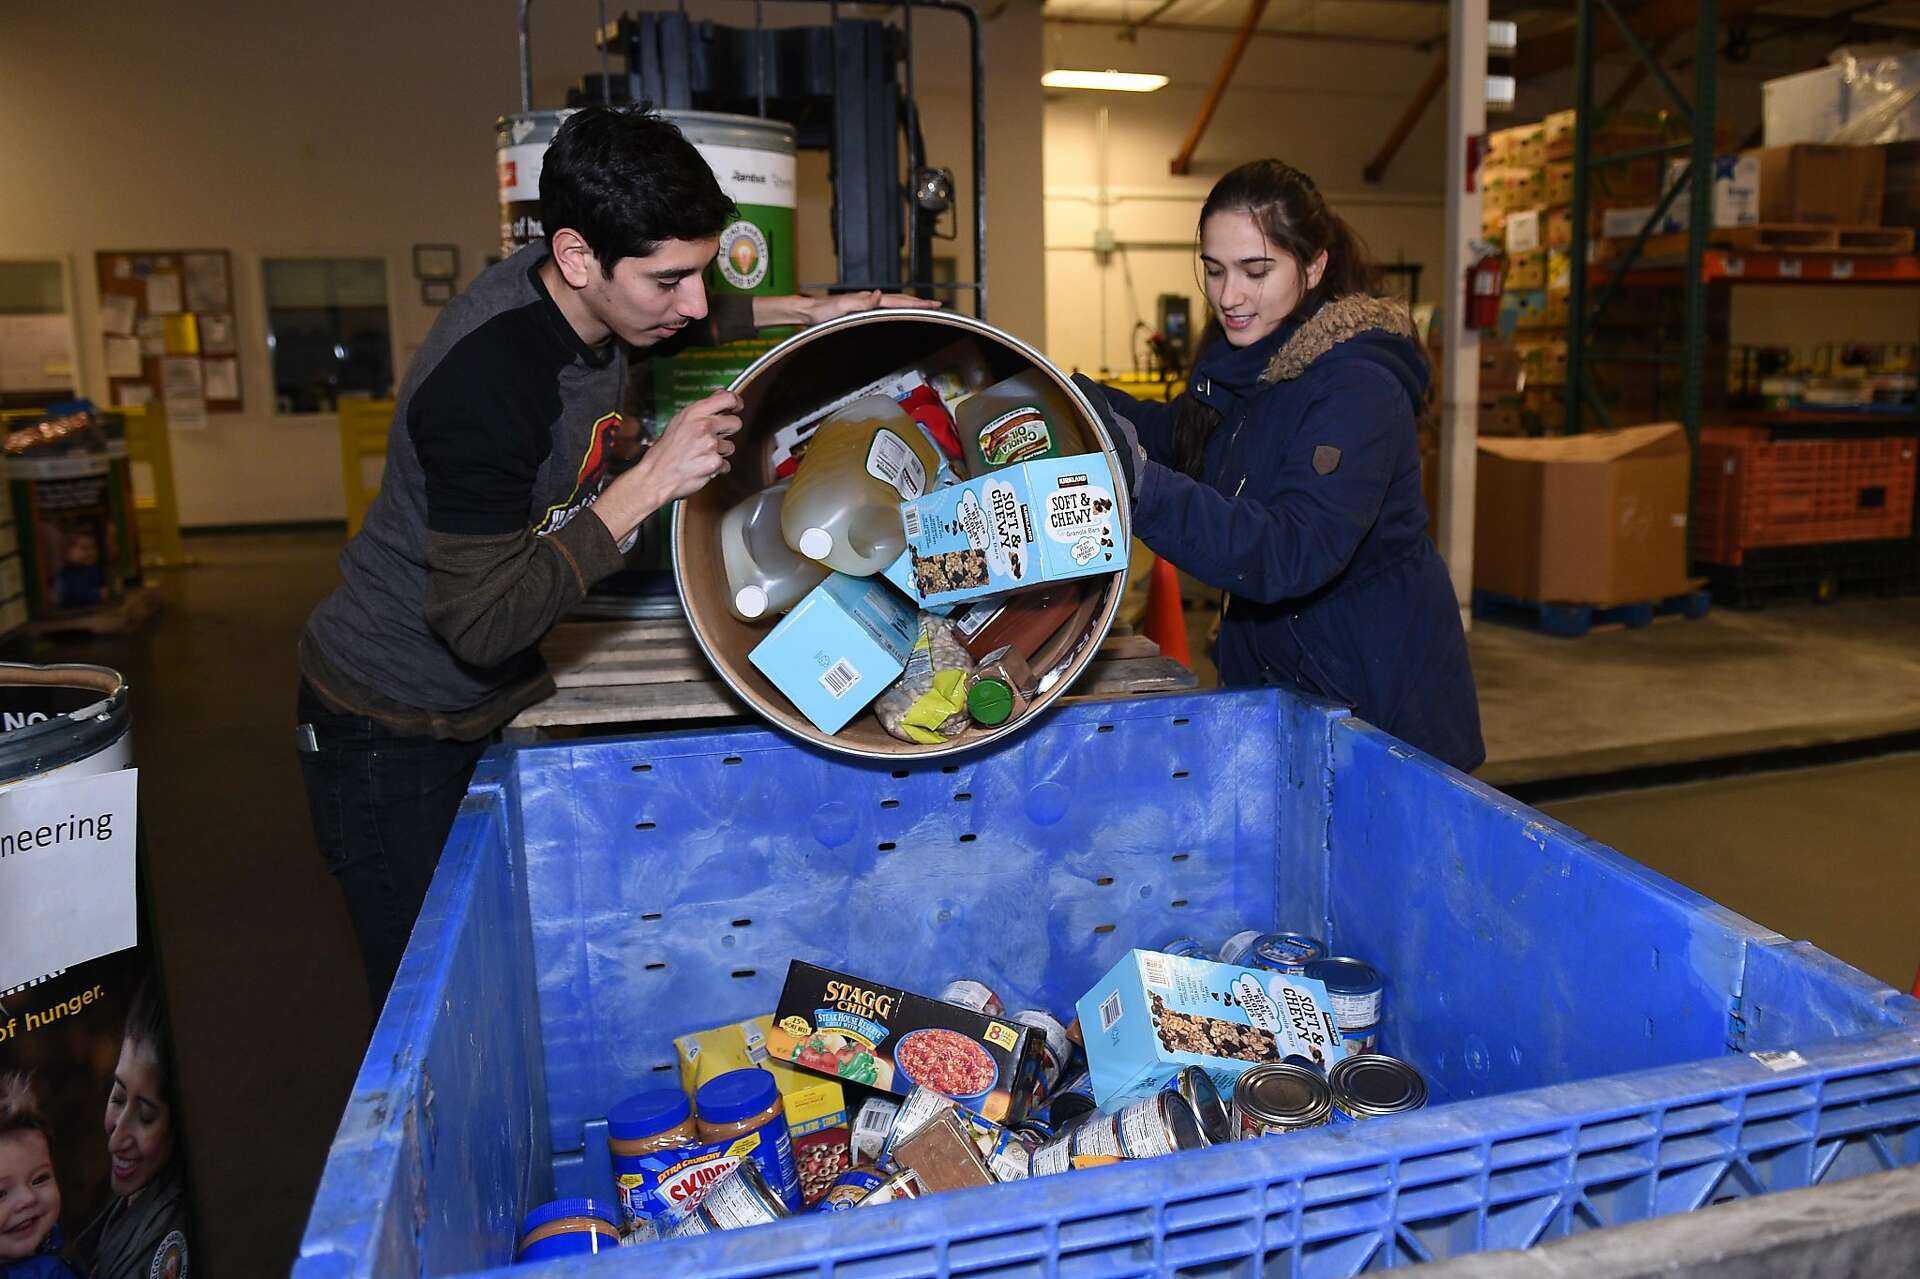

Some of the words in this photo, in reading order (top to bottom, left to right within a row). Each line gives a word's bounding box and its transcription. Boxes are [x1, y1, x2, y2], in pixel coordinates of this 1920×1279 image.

[1001, 431, 1037, 453] CANOLA
[1010, 426, 1027, 439] OIL
[1050, 508, 1092, 528] CHEWY
[1051, 494, 1077, 512] SOFT
[1080, 492, 1091, 507] &
[963, 503, 982, 547] CHOCOLATE
[991, 489, 1011, 549] CHEWY
[1002, 492, 1019, 530] SOFT
[1011, 534, 1021, 549] &
[1, 813, 113, 858] neering
[25, 984, 105, 1032] hunger.
[823, 980, 893, 1020] STAGG
[837, 1001, 875, 1020] CHILI
[1240, 995, 1256, 1018] CHIPS
[1241, 983, 1268, 1028] CHOCOLATE
[1253, 994, 1268, 1017] REAL
[1283, 988, 1311, 1044] CHEWY
[839, 1012, 859, 1026] HOUSE
[989, 1025, 1002, 1040] 8
[1298, 995, 1321, 1031] SOFT
[1311, 1033, 1325, 1048] &
[657, 1162, 683, 1184] EXTRA
[682, 1152, 722, 1168] CRUNCHY
